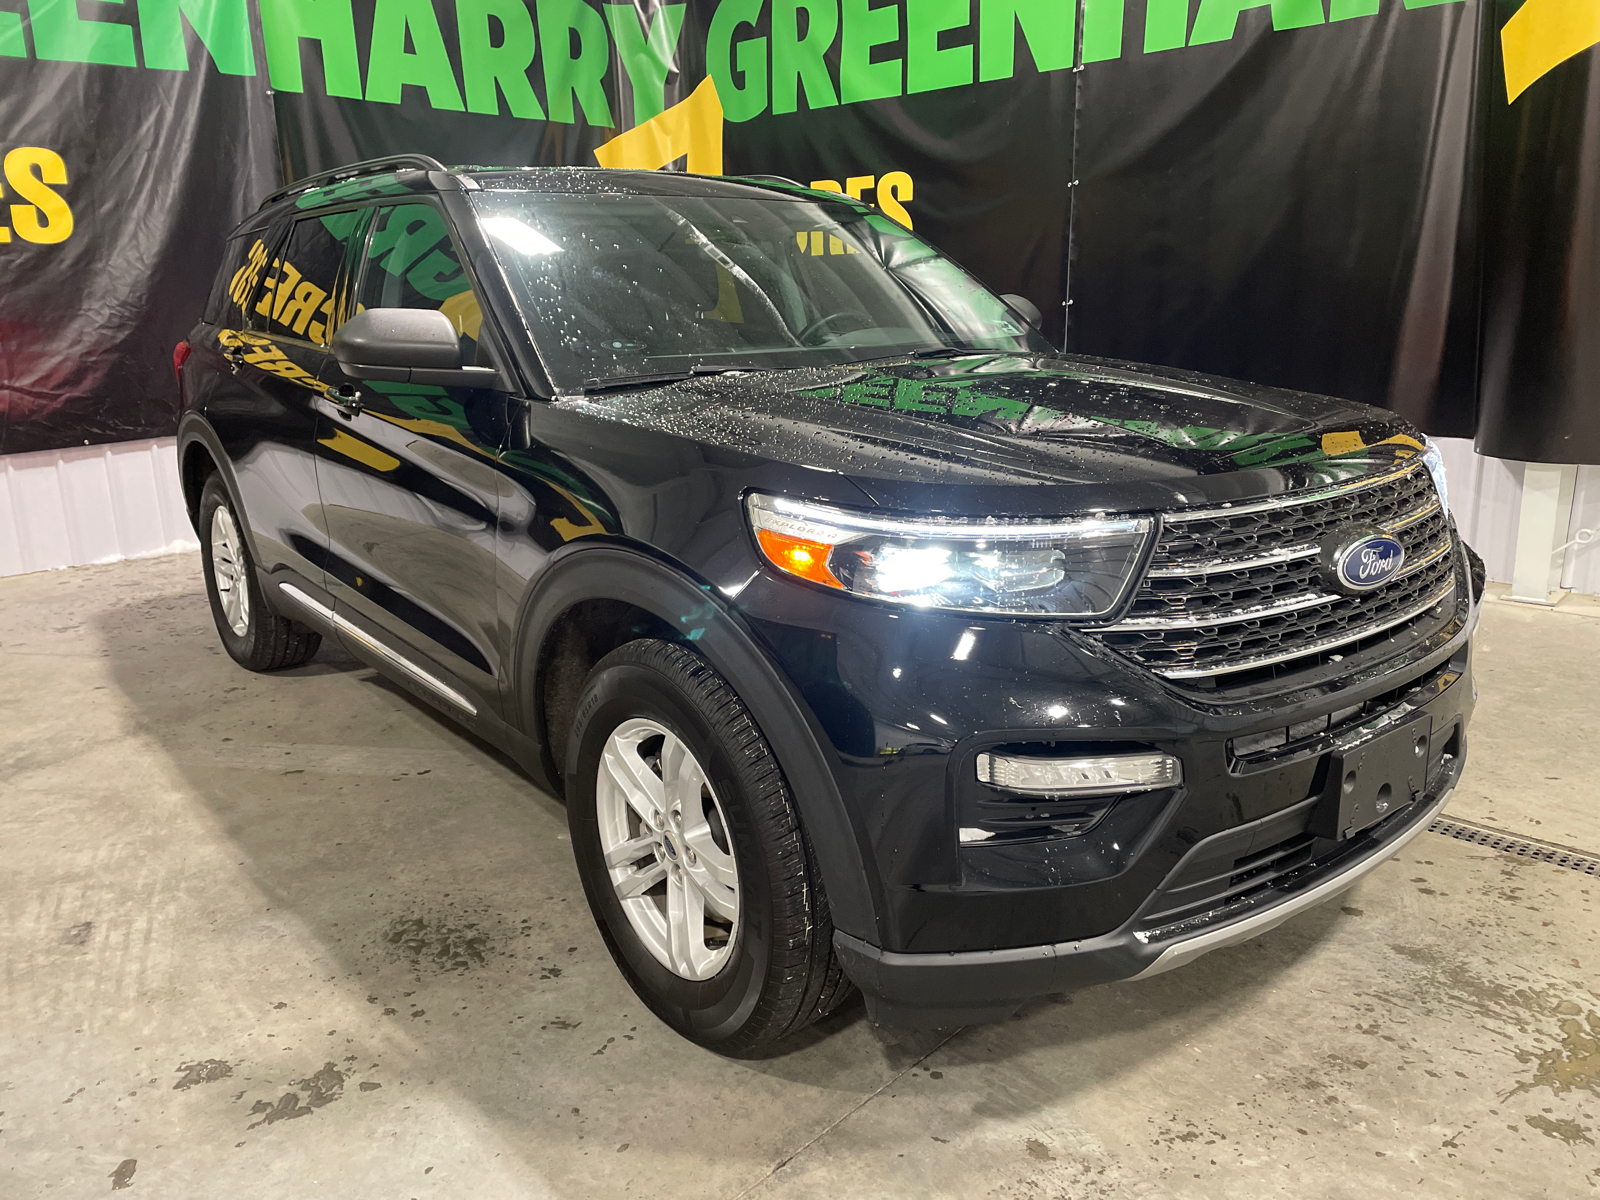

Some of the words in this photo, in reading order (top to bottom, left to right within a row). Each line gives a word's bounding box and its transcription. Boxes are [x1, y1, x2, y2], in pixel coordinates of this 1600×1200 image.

[259, 0, 687, 128] HARRY
[706, 0, 1077, 122] GREEN
[1358, 545, 1394, 580] Ford
